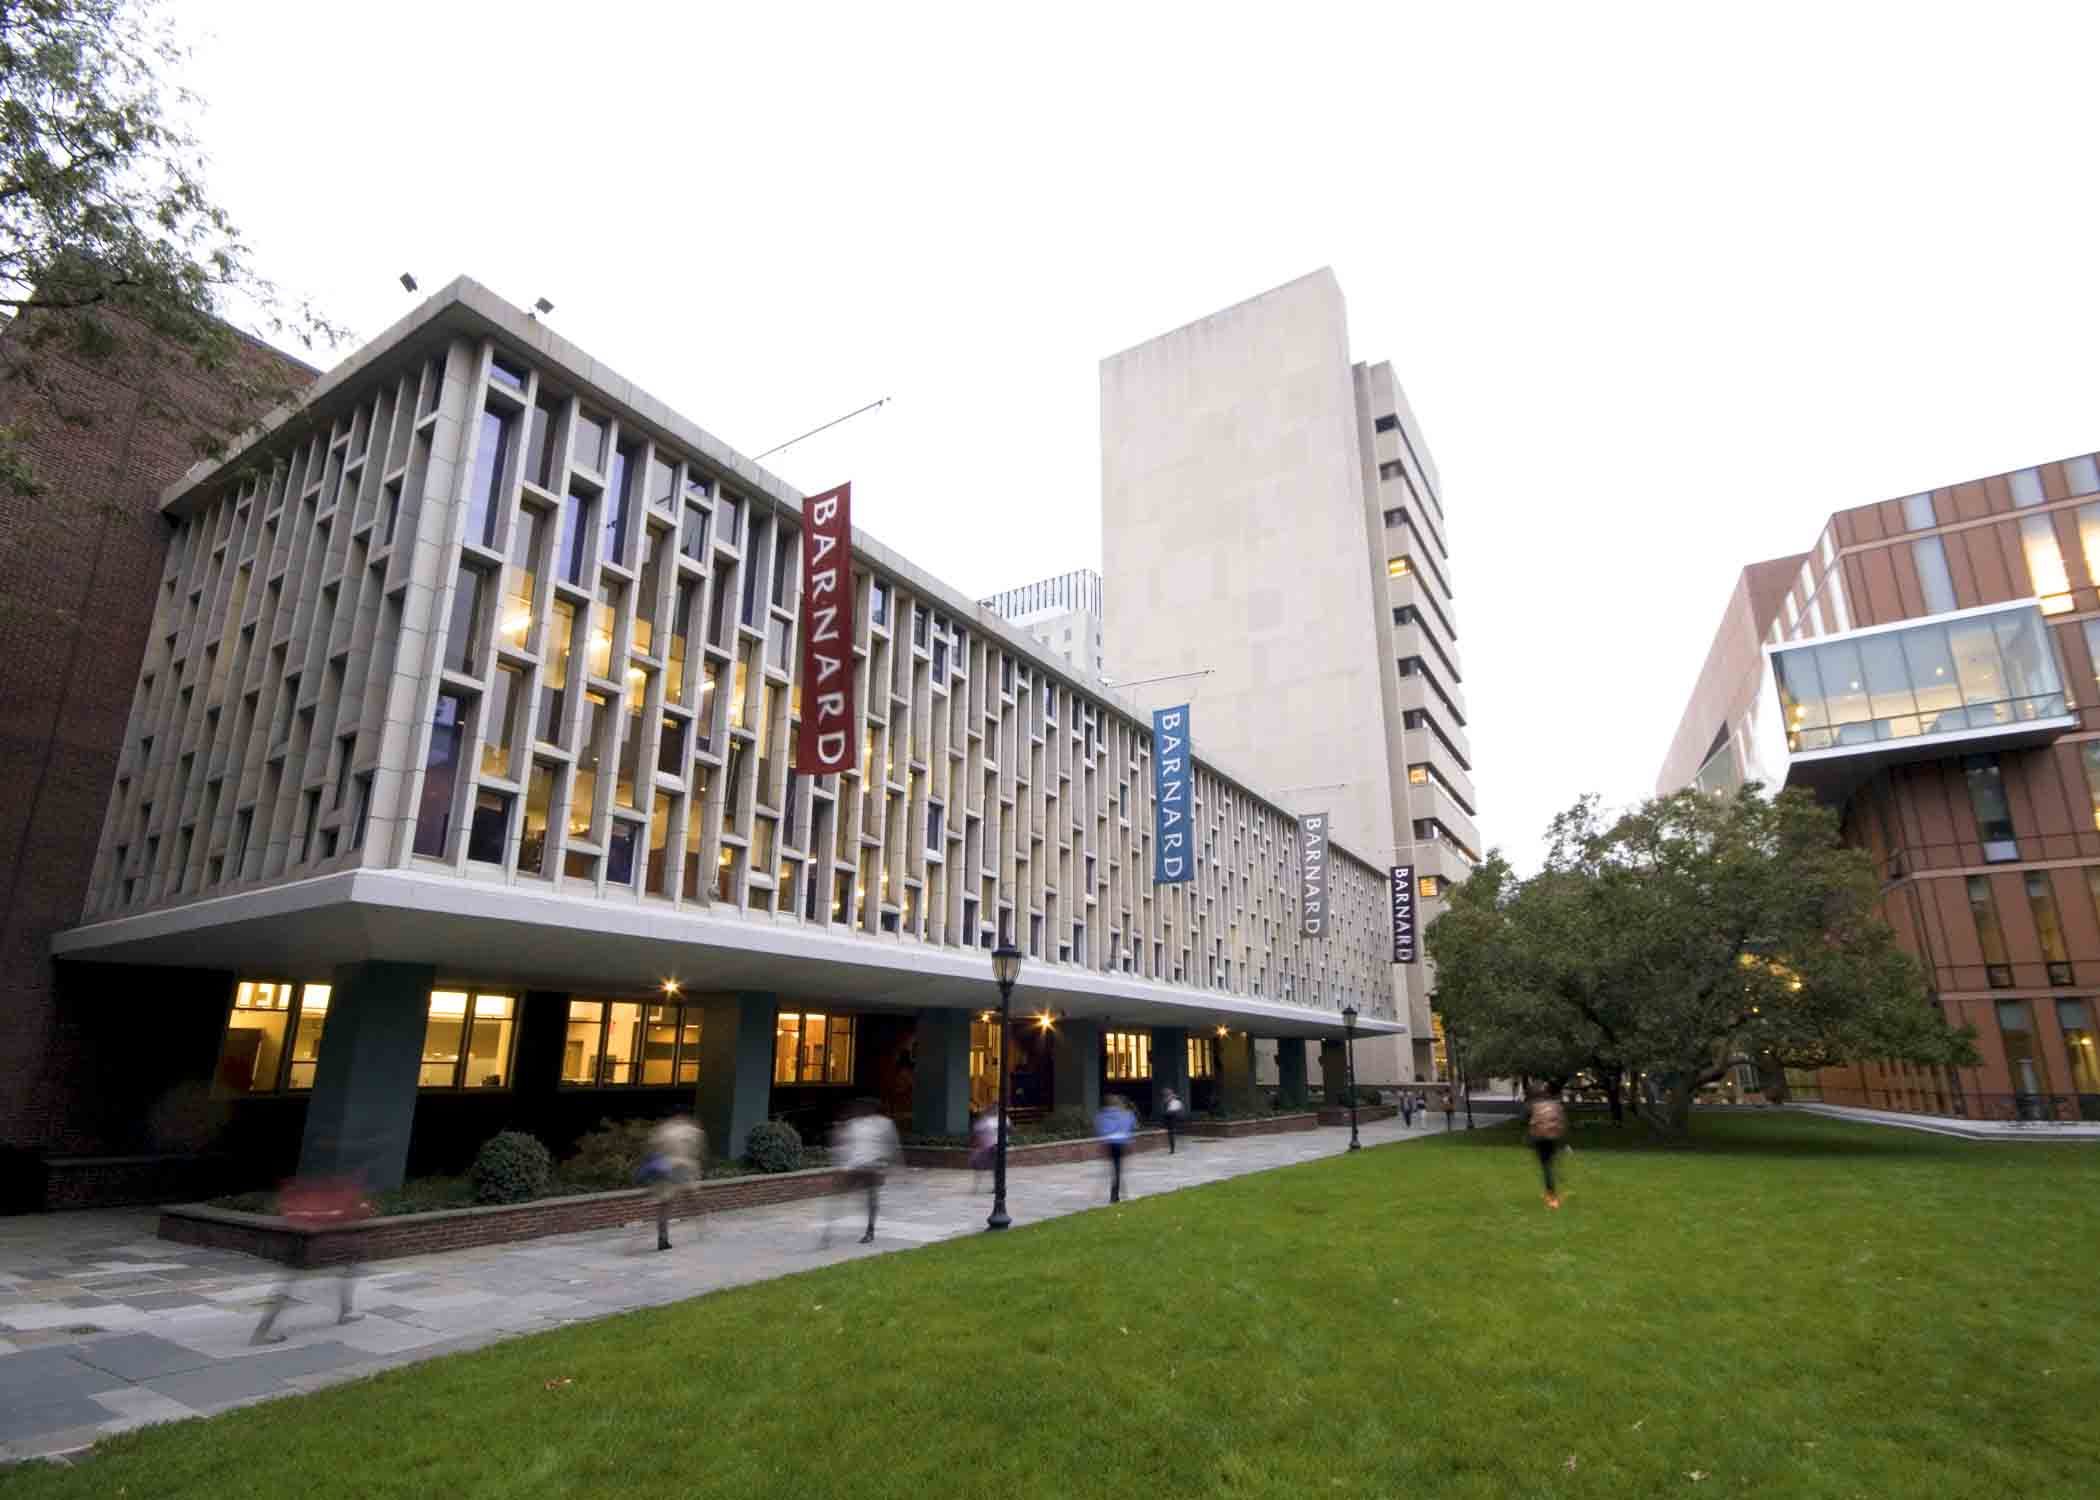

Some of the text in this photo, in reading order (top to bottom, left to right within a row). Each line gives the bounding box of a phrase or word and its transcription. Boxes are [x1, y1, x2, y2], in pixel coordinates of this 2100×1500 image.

[811, 495, 846, 765] BARNARD
[1161, 711, 1184, 878] BARNARD
[1305, 817, 1322, 934] BARNARD
[1394, 868, 1412, 961] BARNARD
